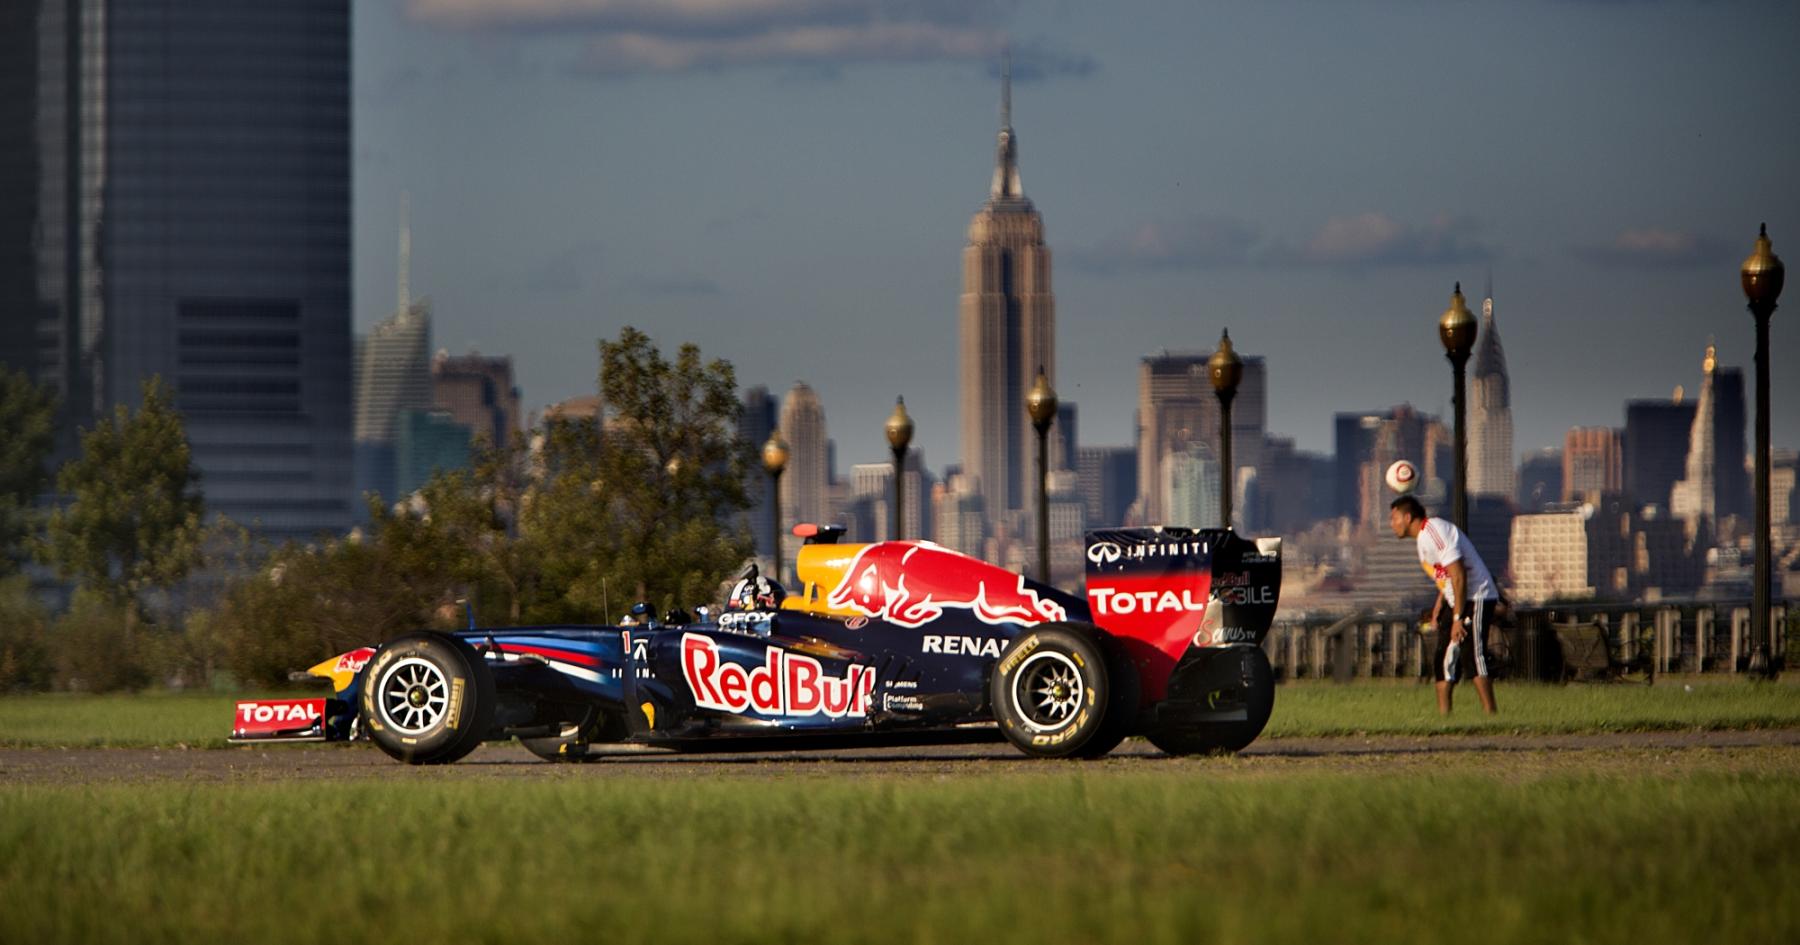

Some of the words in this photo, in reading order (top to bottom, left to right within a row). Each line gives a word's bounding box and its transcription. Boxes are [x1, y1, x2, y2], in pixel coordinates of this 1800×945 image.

[1127, 542, 1208, 557] INFINITI
[622, 630, 631, 654] 1
[887, 695, 918, 703] Platform
